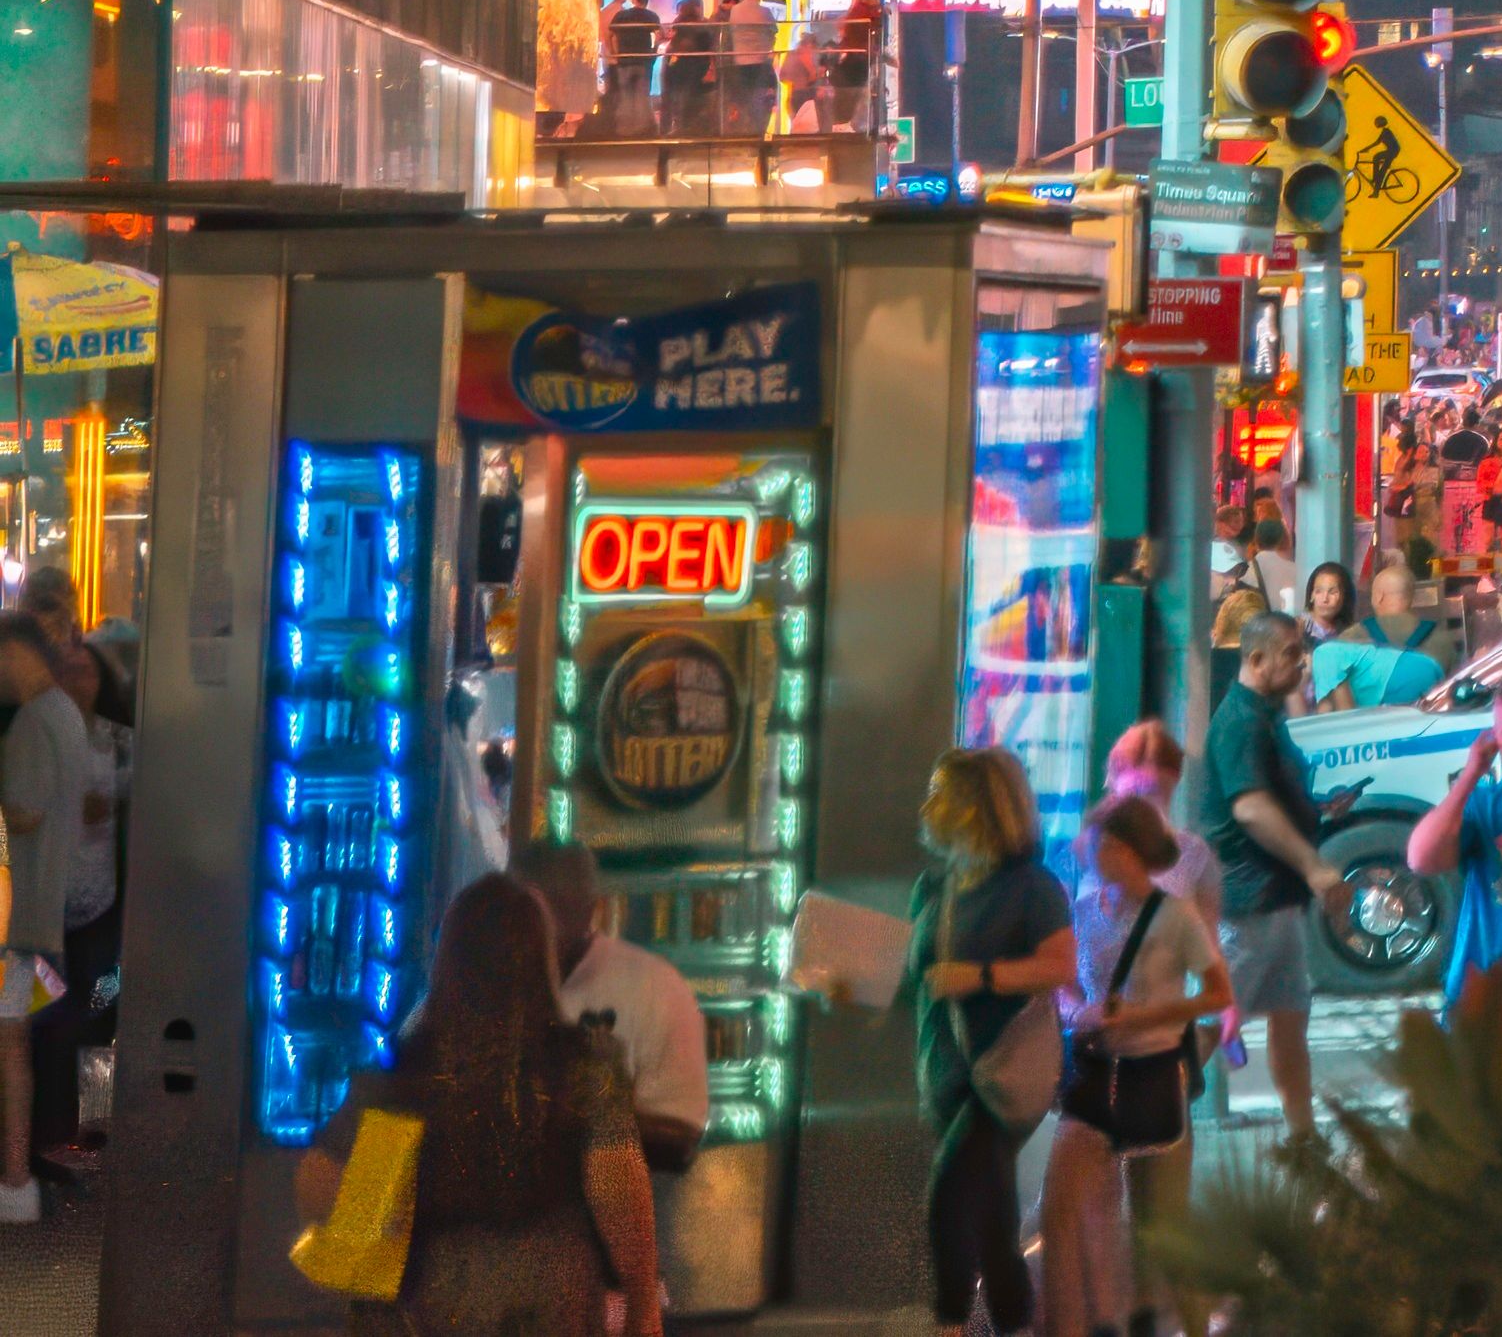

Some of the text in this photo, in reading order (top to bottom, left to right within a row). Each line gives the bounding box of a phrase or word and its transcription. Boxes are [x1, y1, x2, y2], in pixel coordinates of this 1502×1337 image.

[659, 316, 784, 373] PLAY
[1367, 342, 1402, 360] THE
[653, 362, 802, 412] HERE.
[1347, 367, 1376, 385] AD
[581, 516, 748, 592] OPEN
